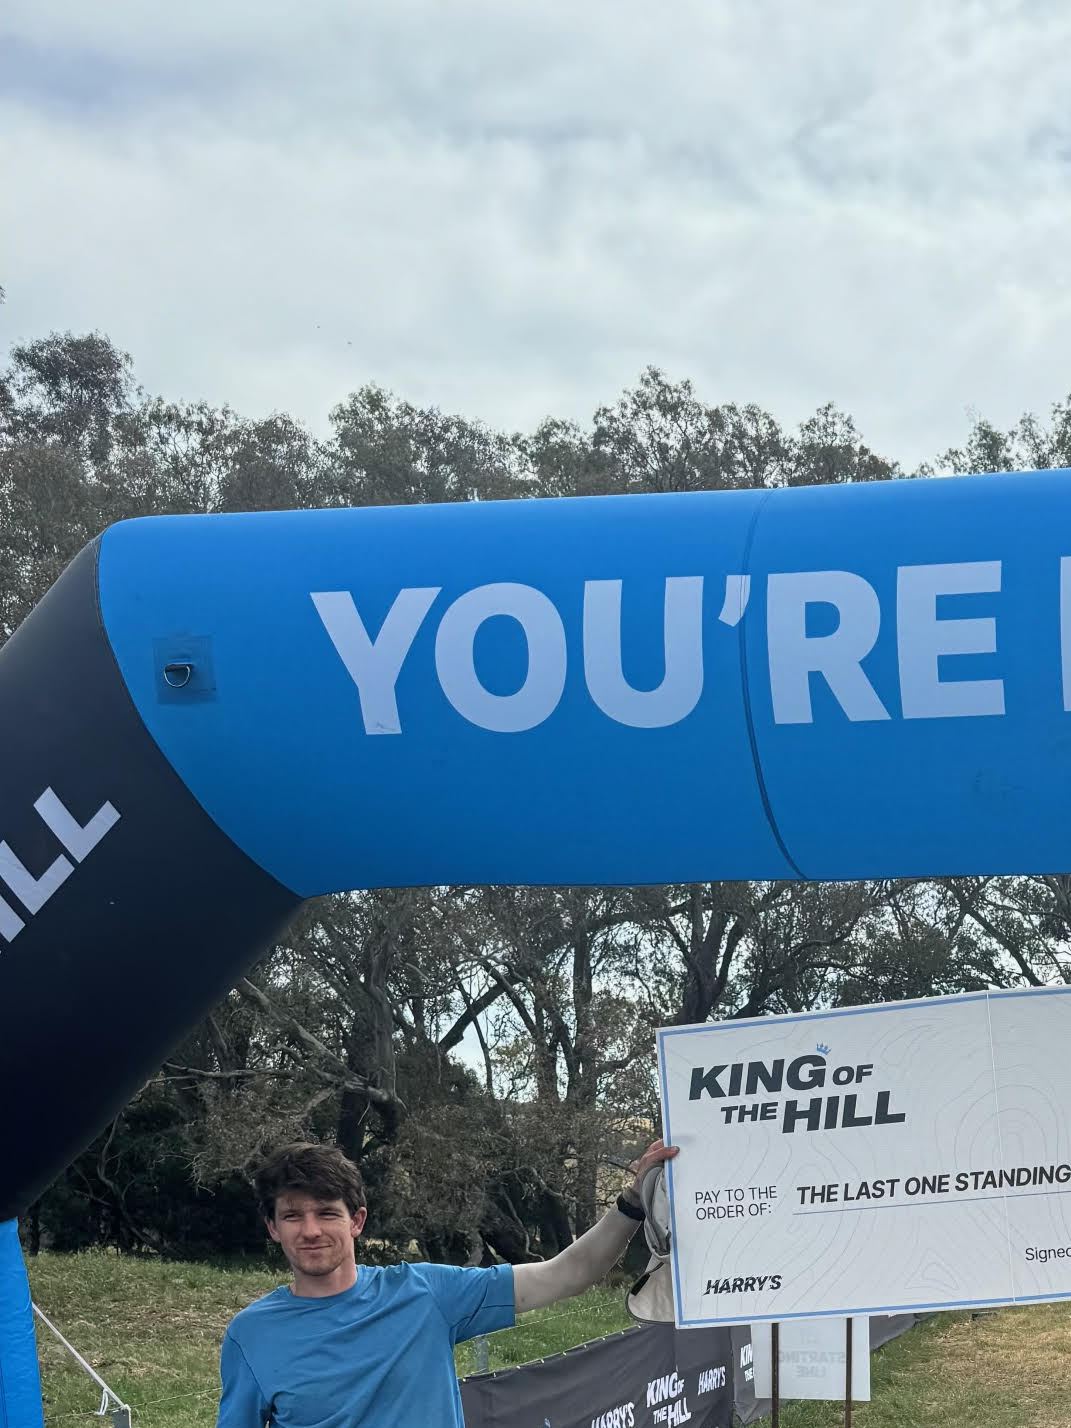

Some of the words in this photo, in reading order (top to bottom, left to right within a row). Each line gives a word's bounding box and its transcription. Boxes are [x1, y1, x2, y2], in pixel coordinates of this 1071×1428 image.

[310, 560, 1006, 735] YOU'RE
[0, 786, 122, 943] LL
[689, 1055, 827, 1100] KING
[832, 1064, 873, 1086] OF
[721, 1102, 778, 1124] THE
[782, 1091, 905, 1133] HILL
[695, 1190, 720, 1204] PAY
[725, 1188, 745, 1202] TO
[749, 1186, 778, 1200] THE
[797, 1183, 839, 1205] THE
[843, 1178, 900, 1201] LAST
[904, 1174, 950, 1196] ONE
[955, 1164, 1071, 1192] STANDING
[696, 1205, 745, 1220] ORDER
[748, 1202, 772, 1217] OF:
[703, 1275, 783, 1296] HARRY'S
[740, 1344, 753, 1368] KIN
[646, 1372, 678, 1408] KING
[676, 1378, 685, 1394] OF
[697, 1366, 726, 1396] HARRY'S
[653, 1407, 668, 1425] THE
[667, 1397, 692, 1428] HILL
